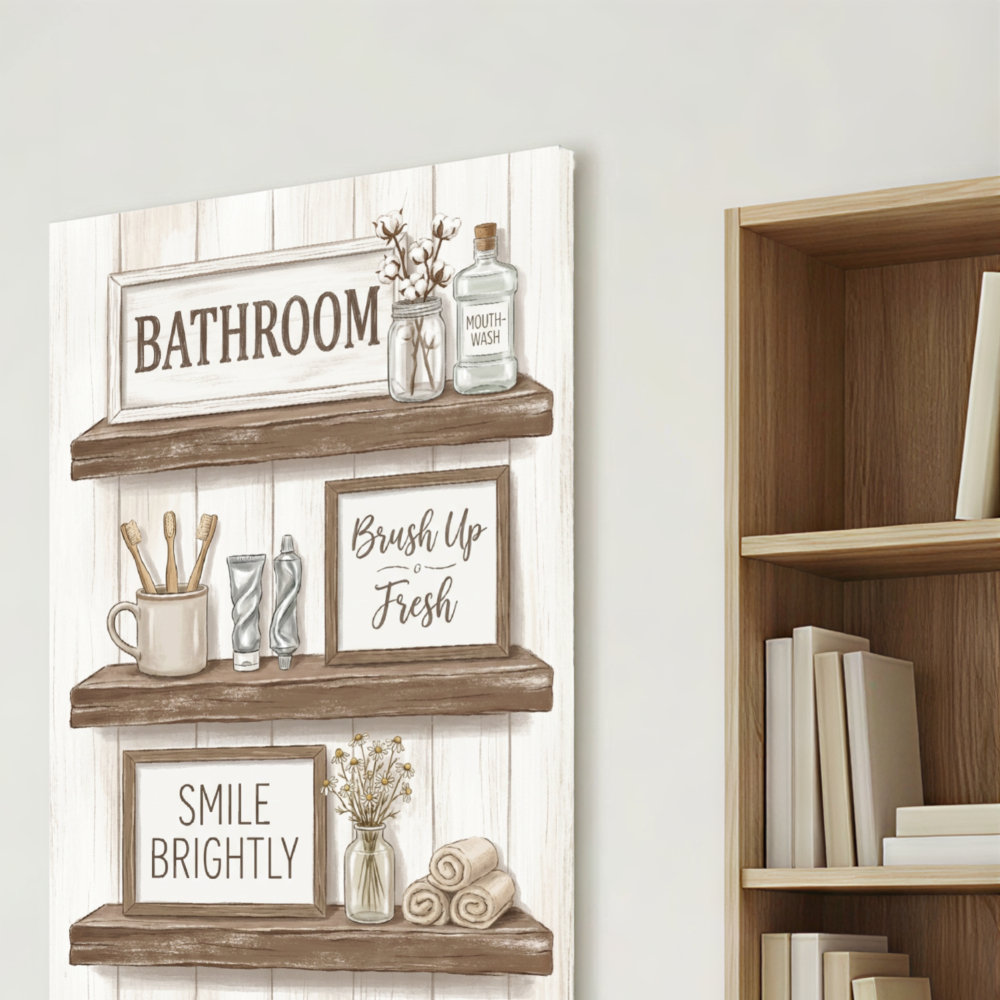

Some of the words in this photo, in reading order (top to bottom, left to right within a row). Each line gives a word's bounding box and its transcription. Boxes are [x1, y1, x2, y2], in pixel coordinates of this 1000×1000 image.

[134, 285, 380, 373] BATHROOM
[466, 312, 506, 330] MOUTH-
[471, 330, 500, 347] WASH
[352, 508, 438, 559] Brush
[444, 508, 487, 561] Up
[372, 576, 458, 629] Fresh
[178, 782, 270, 826] SMILE
[151, 837, 299, 880] BRIGHTLY
